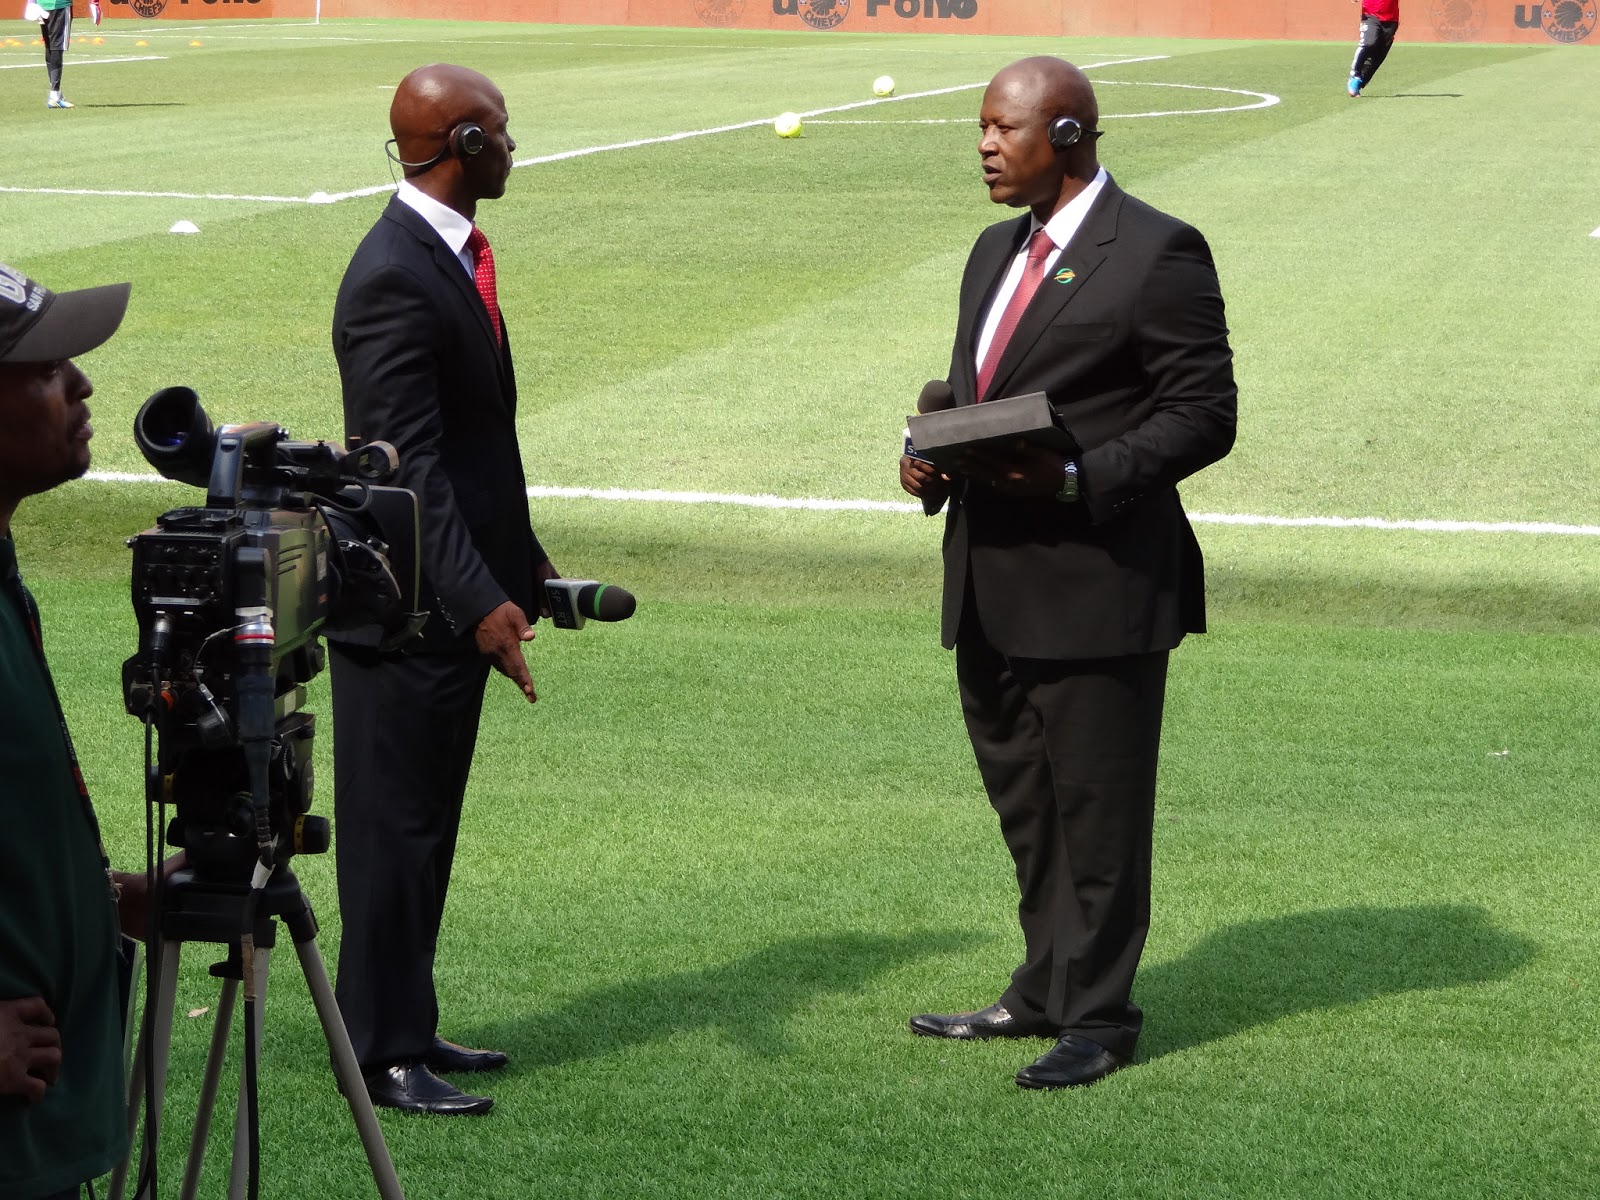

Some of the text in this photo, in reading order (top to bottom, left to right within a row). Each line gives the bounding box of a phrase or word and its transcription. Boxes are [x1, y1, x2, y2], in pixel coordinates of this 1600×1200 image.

[134, 0, 163, 16] CHIEFS
[804, 10, 843, 28] CHIEFS
[1548, 23, 1589, 41] CHIEFS
